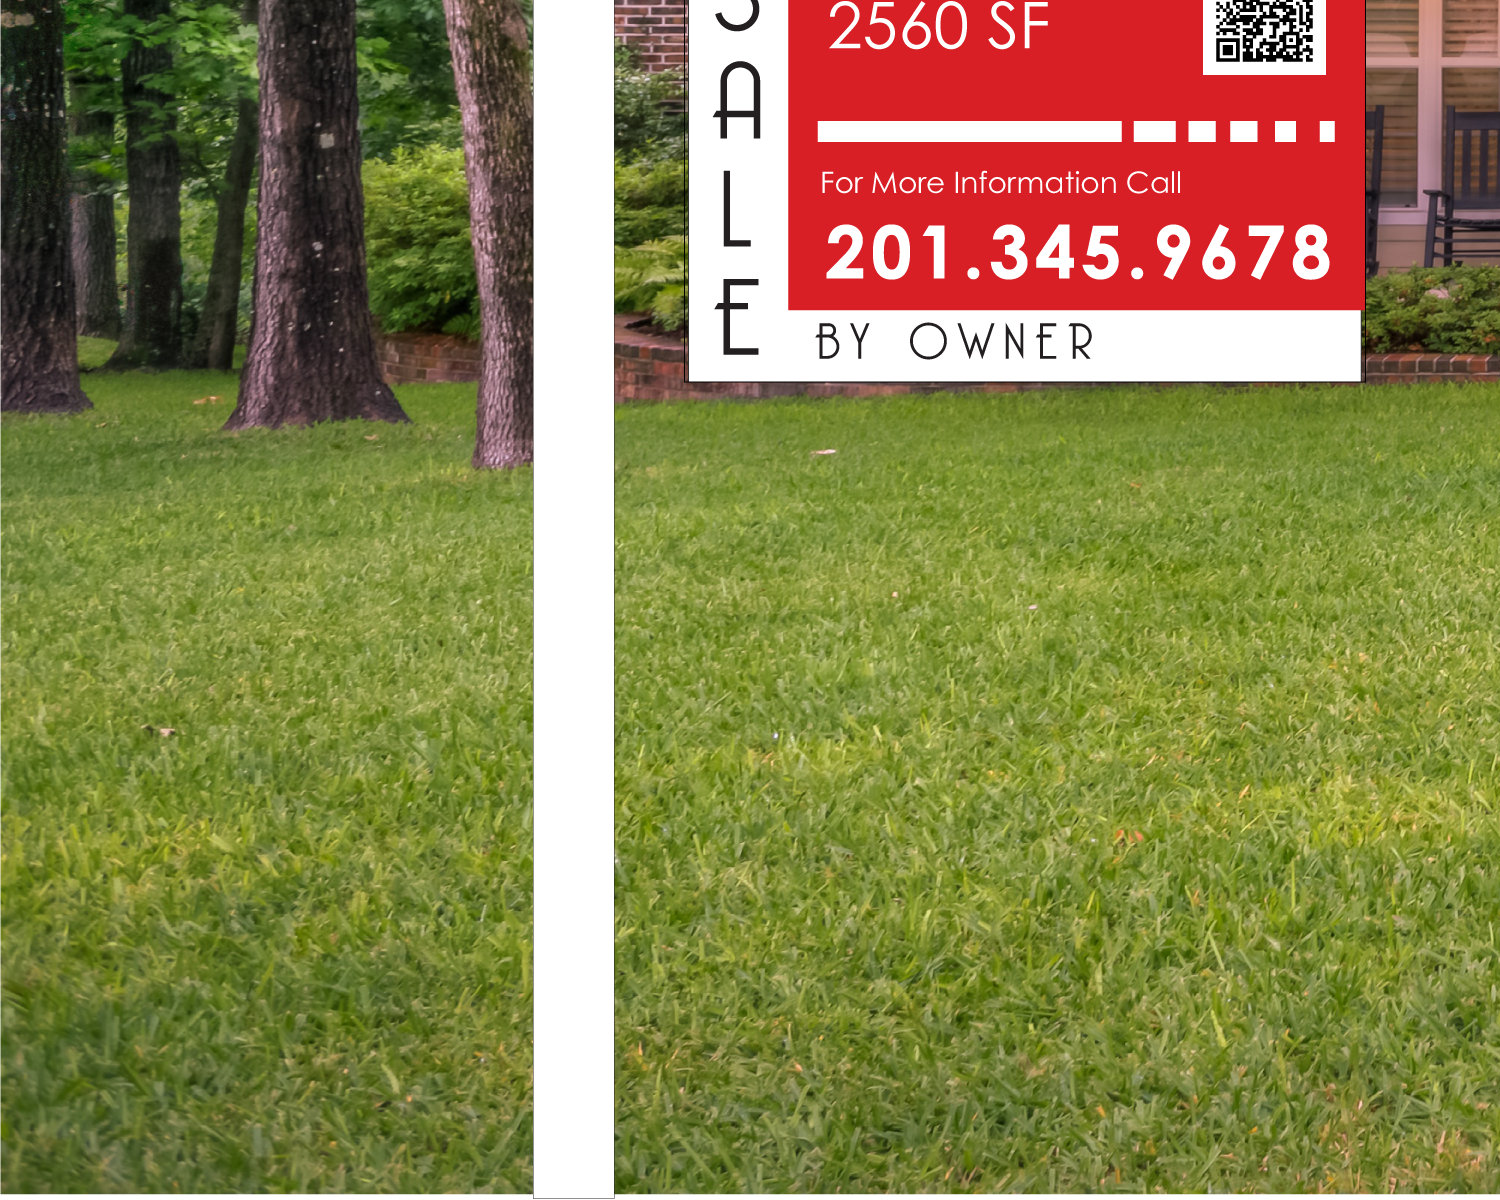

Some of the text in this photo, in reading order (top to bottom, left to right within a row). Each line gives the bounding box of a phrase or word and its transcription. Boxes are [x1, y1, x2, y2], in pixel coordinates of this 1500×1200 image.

[830, 1, 1048, 49] 2560 SF
[822, 171, 1180, 194] For More Information Call
[826, 224, 1330, 280] 201.345.9678
[816, 322, 1092, 359] BY OWNER
